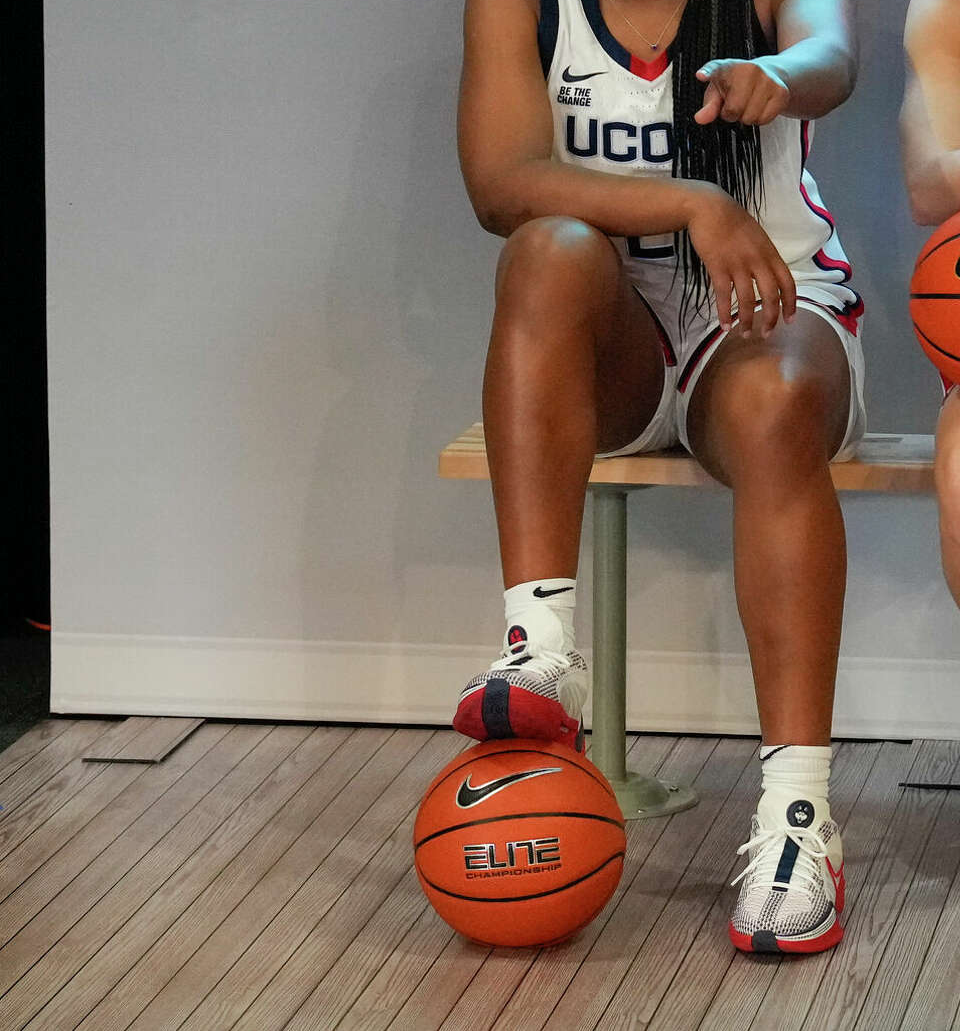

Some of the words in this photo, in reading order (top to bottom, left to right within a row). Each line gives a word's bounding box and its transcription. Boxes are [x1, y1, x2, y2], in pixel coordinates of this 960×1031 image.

[560, 86, 572, 96] BE
[575, 87, 592, 98] THE
[557, 95, 592, 107] CHANGE
[566, 115, 675, 163] UCO
[463, 837, 561, 870] ELITE
[465, 863, 563, 880] CHAMPIONSHIP
